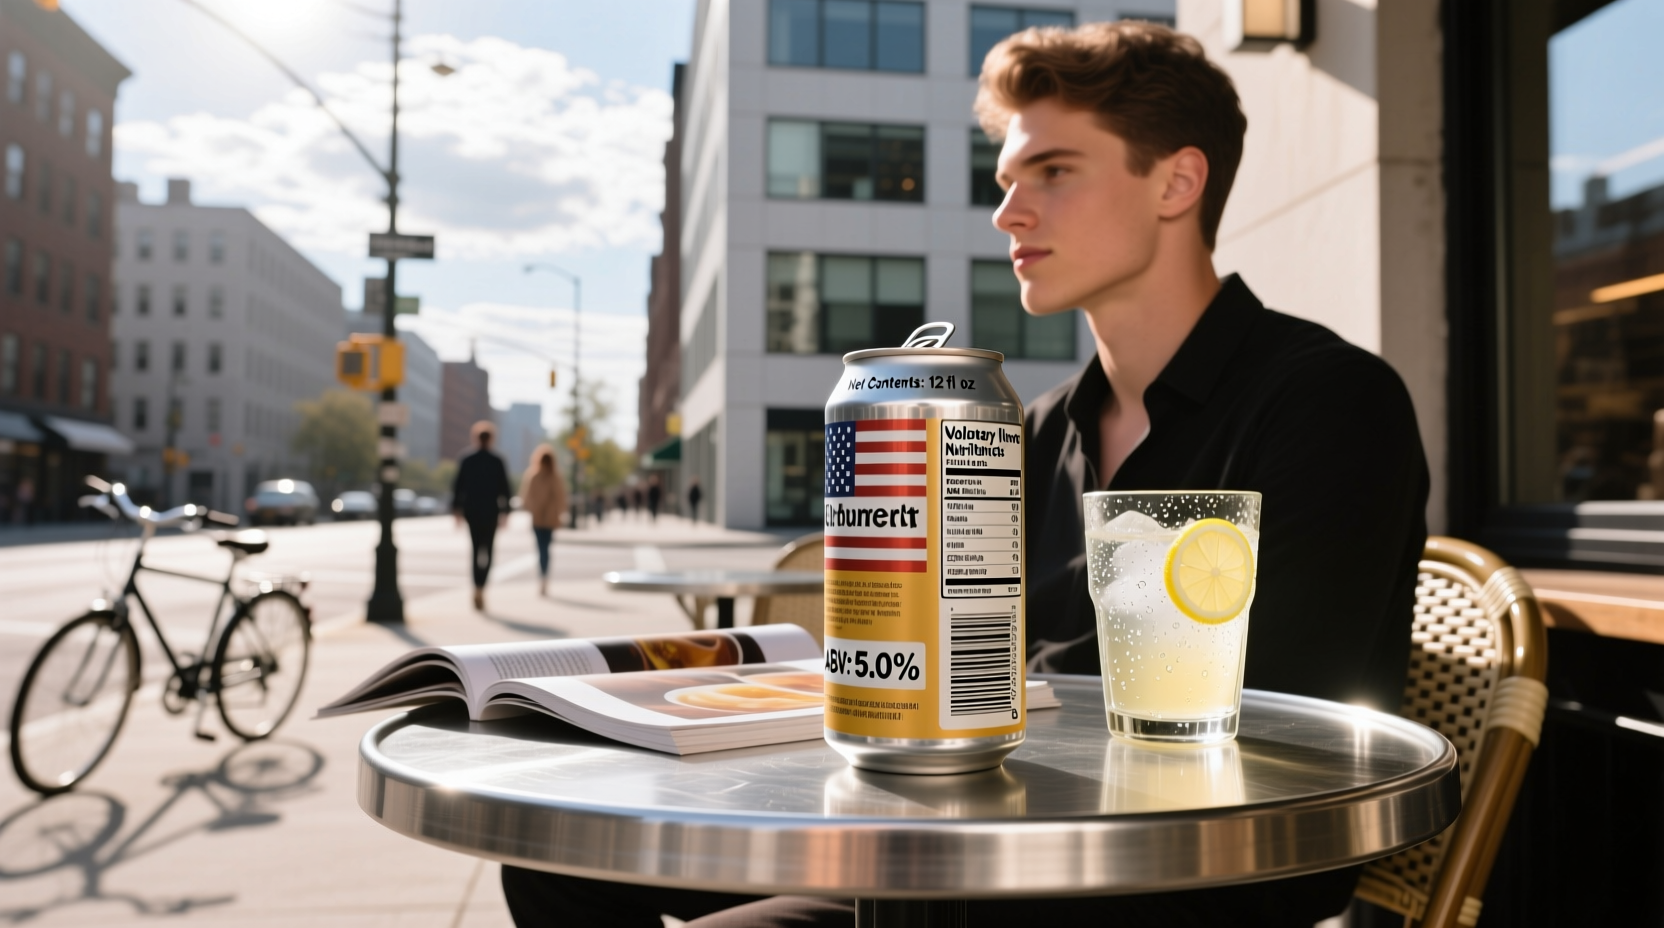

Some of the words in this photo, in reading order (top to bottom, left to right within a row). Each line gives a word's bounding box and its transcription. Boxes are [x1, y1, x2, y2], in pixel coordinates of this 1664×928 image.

[868, 376, 925, 390] Contents:
[929, 375, 944, 389] 12
[946, 374, 956, 390] fl
[960, 378, 976, 390] oz
[825, 648, 852, 675] ABV:
[854, 650, 920, 681] 5.0%
